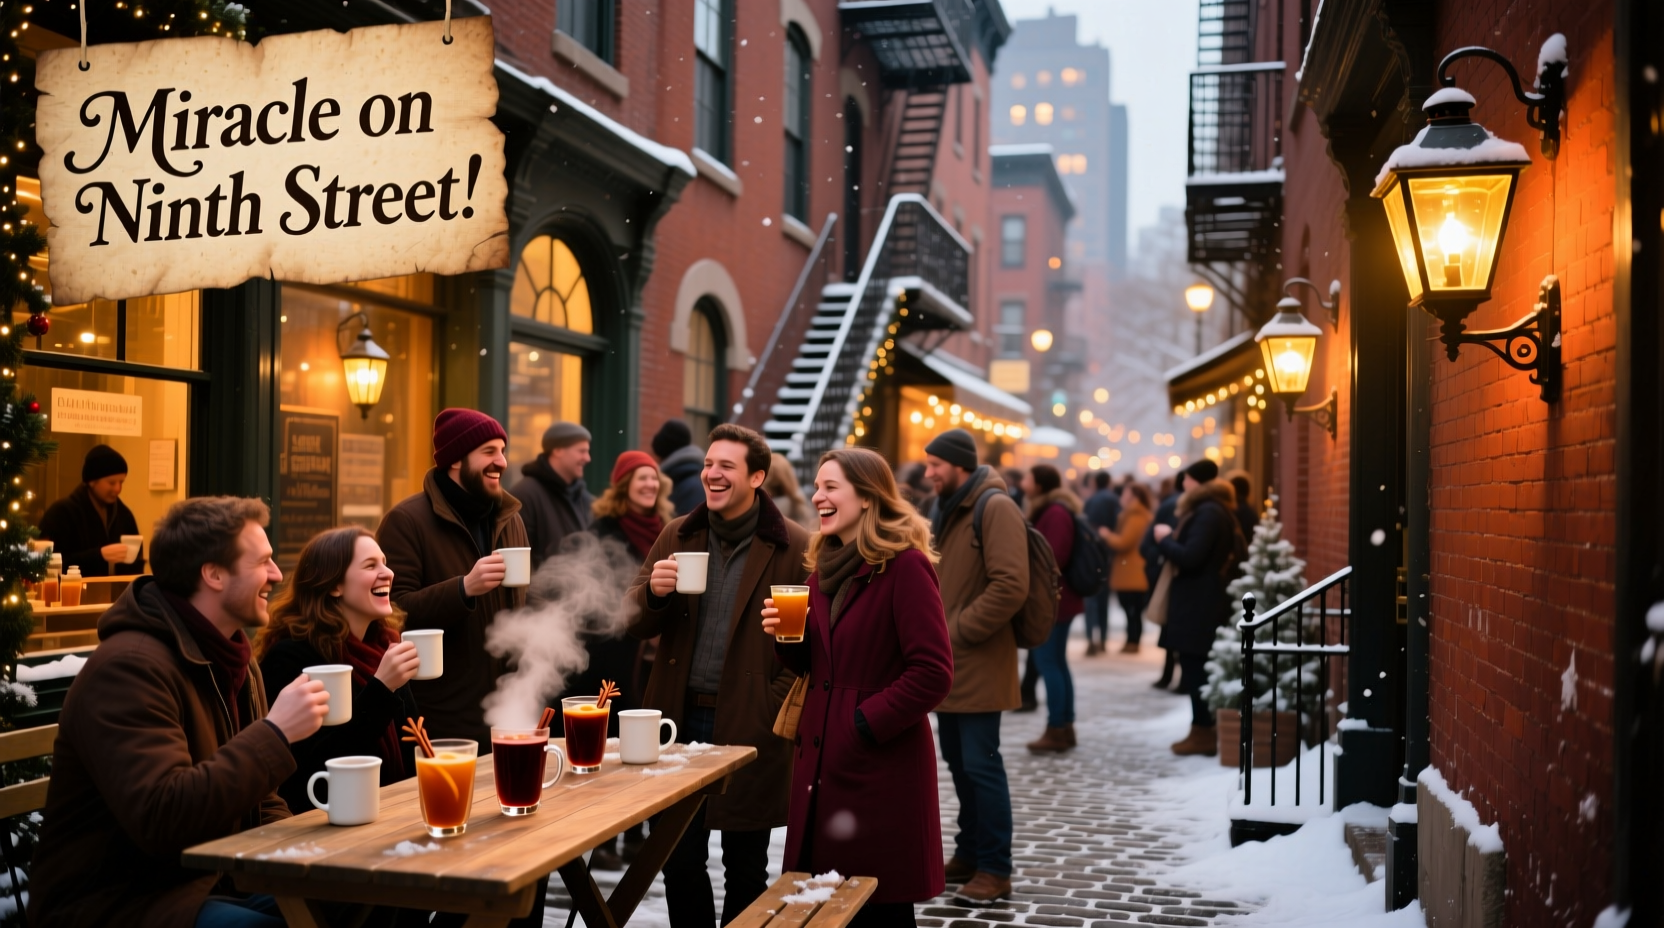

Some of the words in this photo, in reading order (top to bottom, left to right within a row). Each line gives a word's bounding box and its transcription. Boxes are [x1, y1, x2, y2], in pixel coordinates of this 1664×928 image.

[64, 77, 341, 177] Miracle
[359, 91, 434, 138] on
[75, 171, 263, 247] Ninth
[280, 154, 483, 236] Street!
